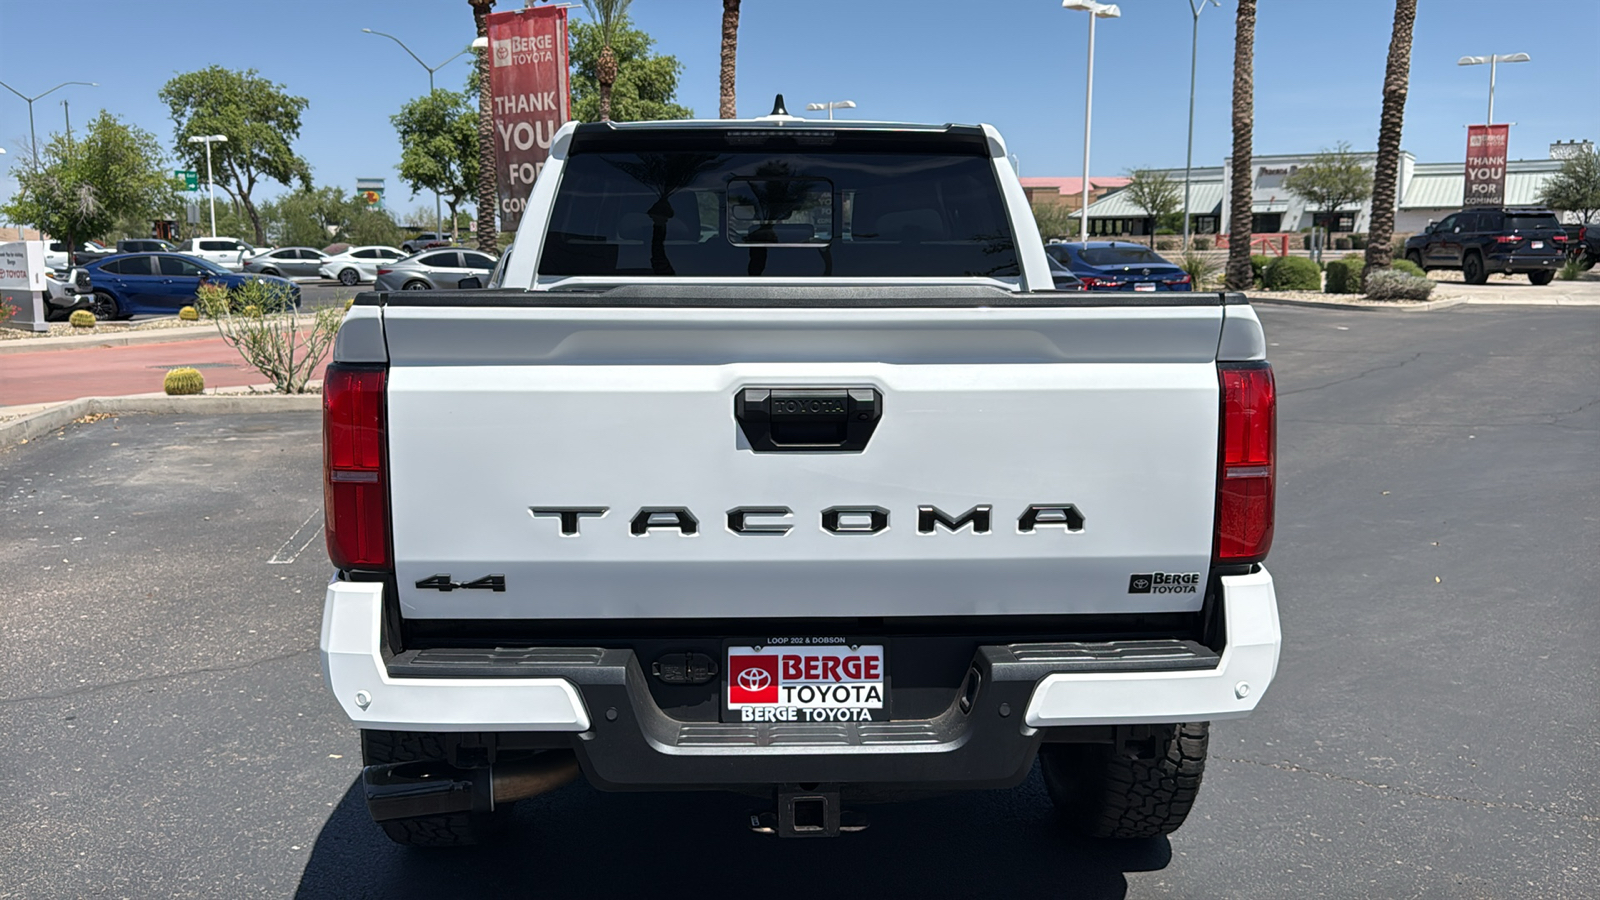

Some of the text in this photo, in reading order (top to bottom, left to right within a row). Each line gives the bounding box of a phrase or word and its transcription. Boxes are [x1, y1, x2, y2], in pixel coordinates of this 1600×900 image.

[512, 34, 553, 53] BERGE
[513, 51, 553, 65] TOYOTA
[495, 91, 557, 115] THANK
[497, 120, 554, 152] YOU
[1468, 156, 1505, 166] THANK
[1468, 168, 1502, 180] YOU
[1471, 183, 1497, 194] FOR
[6, 270, 26, 278] TOYOTA
[774, 400, 845, 413] TOYOTA
[528, 504, 1086, 537] TACOMA
[1153, 572, 1199, 585] BERGE
[1152, 586, 1197, 594] TOYOTA
[782, 655, 881, 683] BERGE
[782, 685, 882, 703] TOYOTA
[741, 706, 872, 722] BERGE TOYOTA
